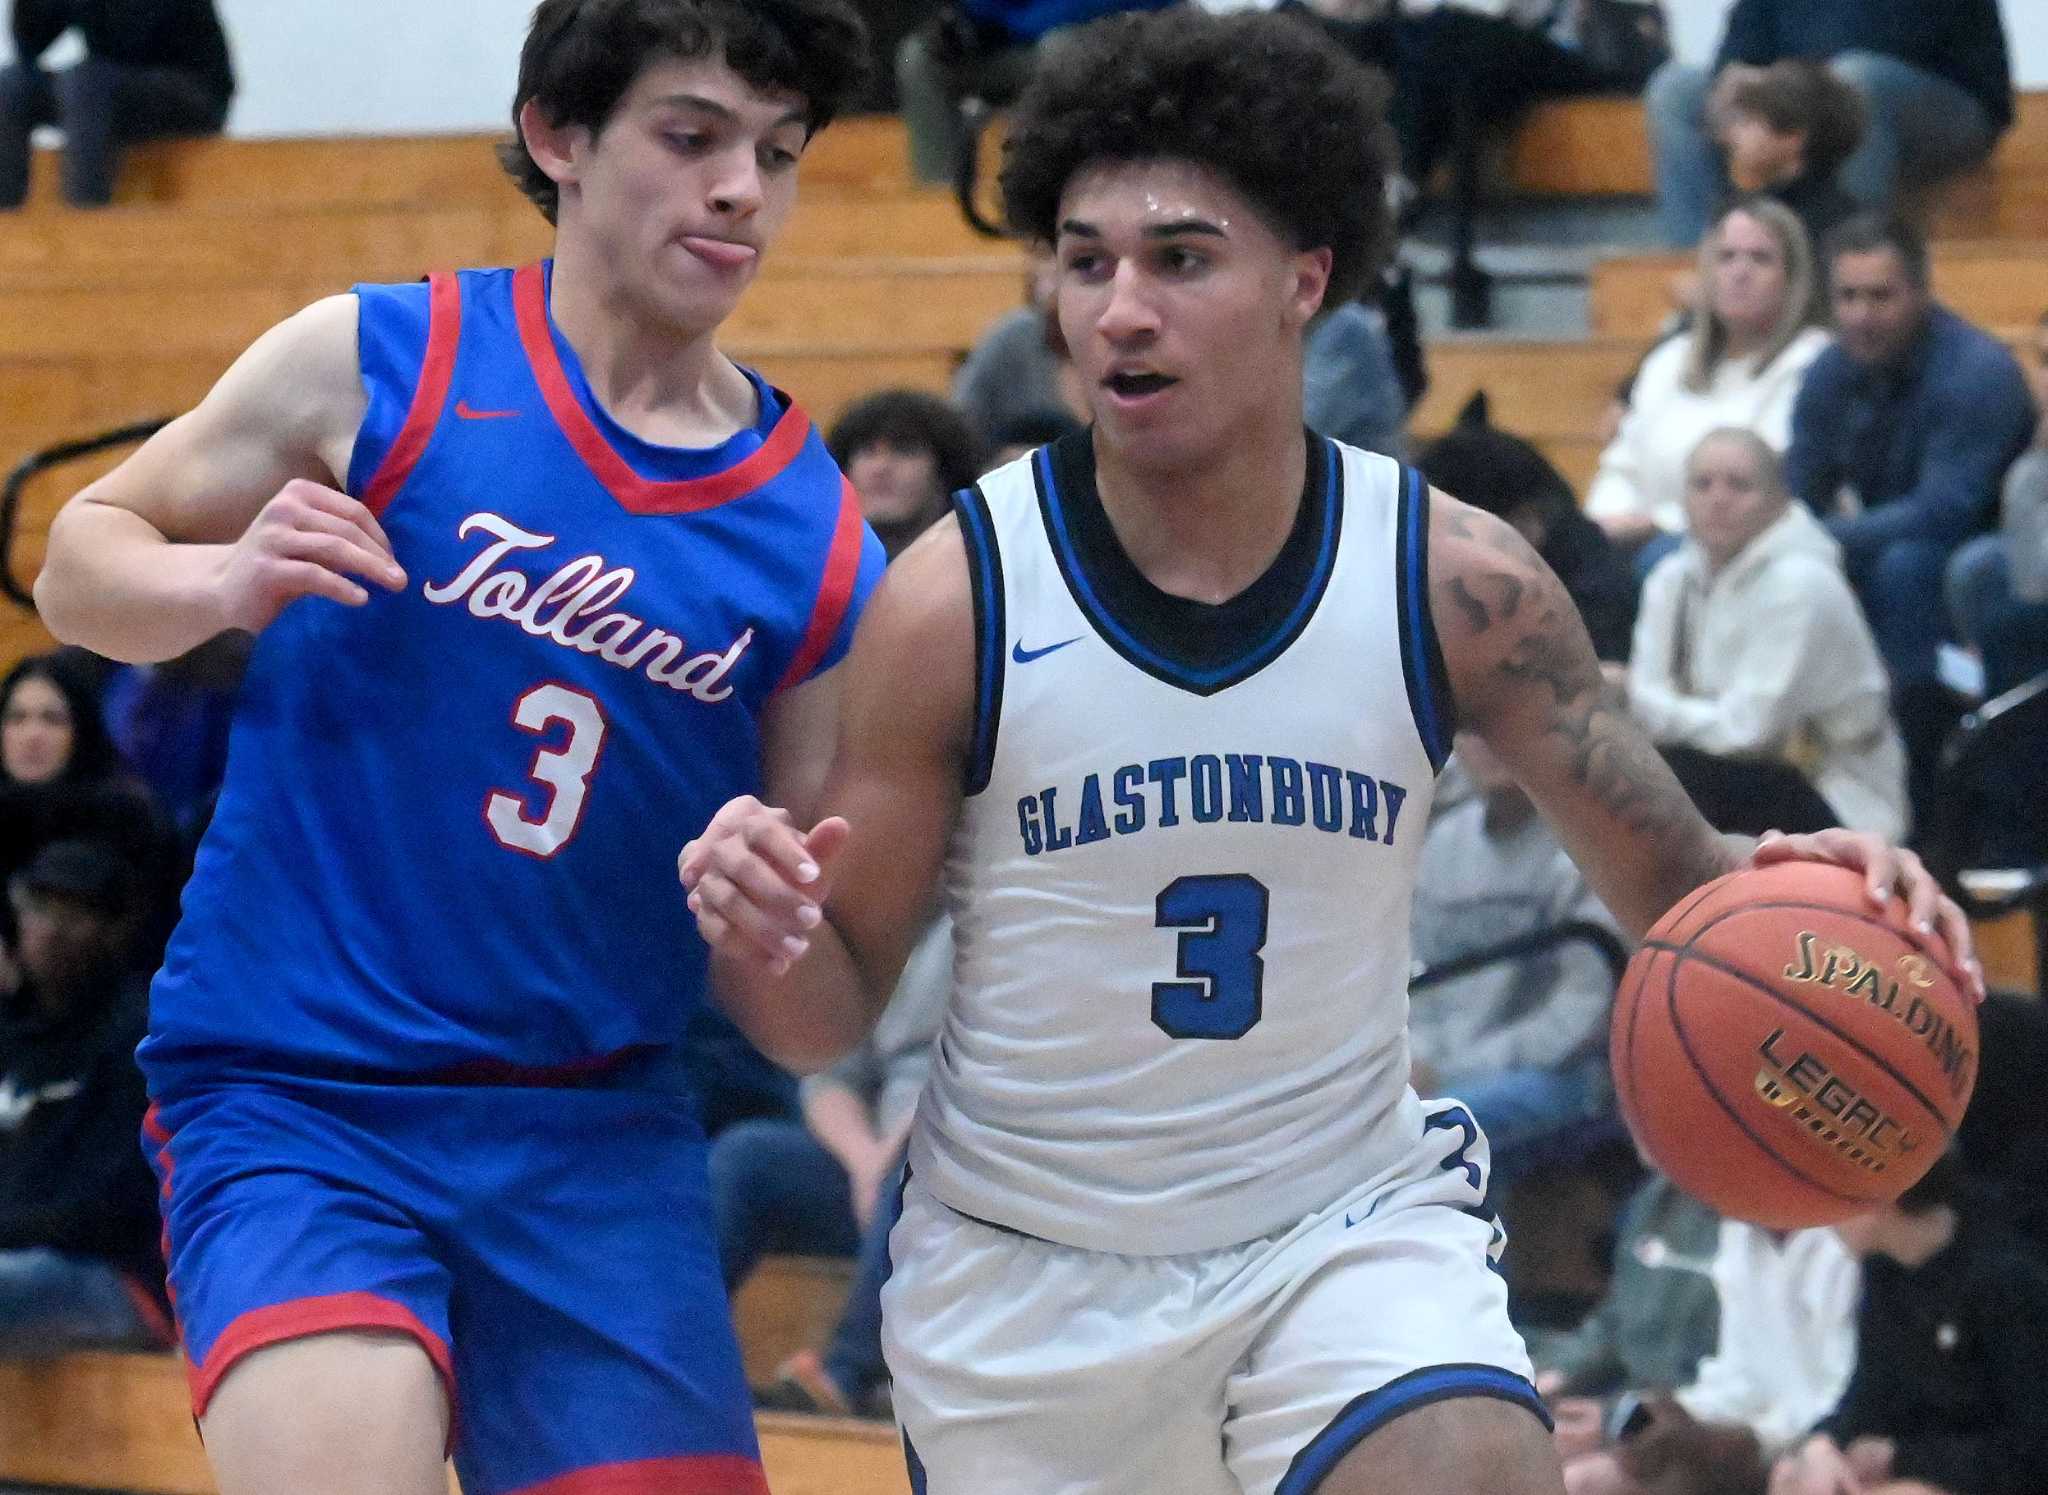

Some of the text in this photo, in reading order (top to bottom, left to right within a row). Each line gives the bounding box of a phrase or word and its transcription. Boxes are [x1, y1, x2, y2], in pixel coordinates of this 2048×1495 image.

[423, 511, 755, 703] Tolland
[483, 680, 608, 860] 3
[1016, 753, 1407, 856] GLASTONBURY
[1150, 873, 1270, 1041] 3
[1758, 1027, 1921, 1152] LEGACY
